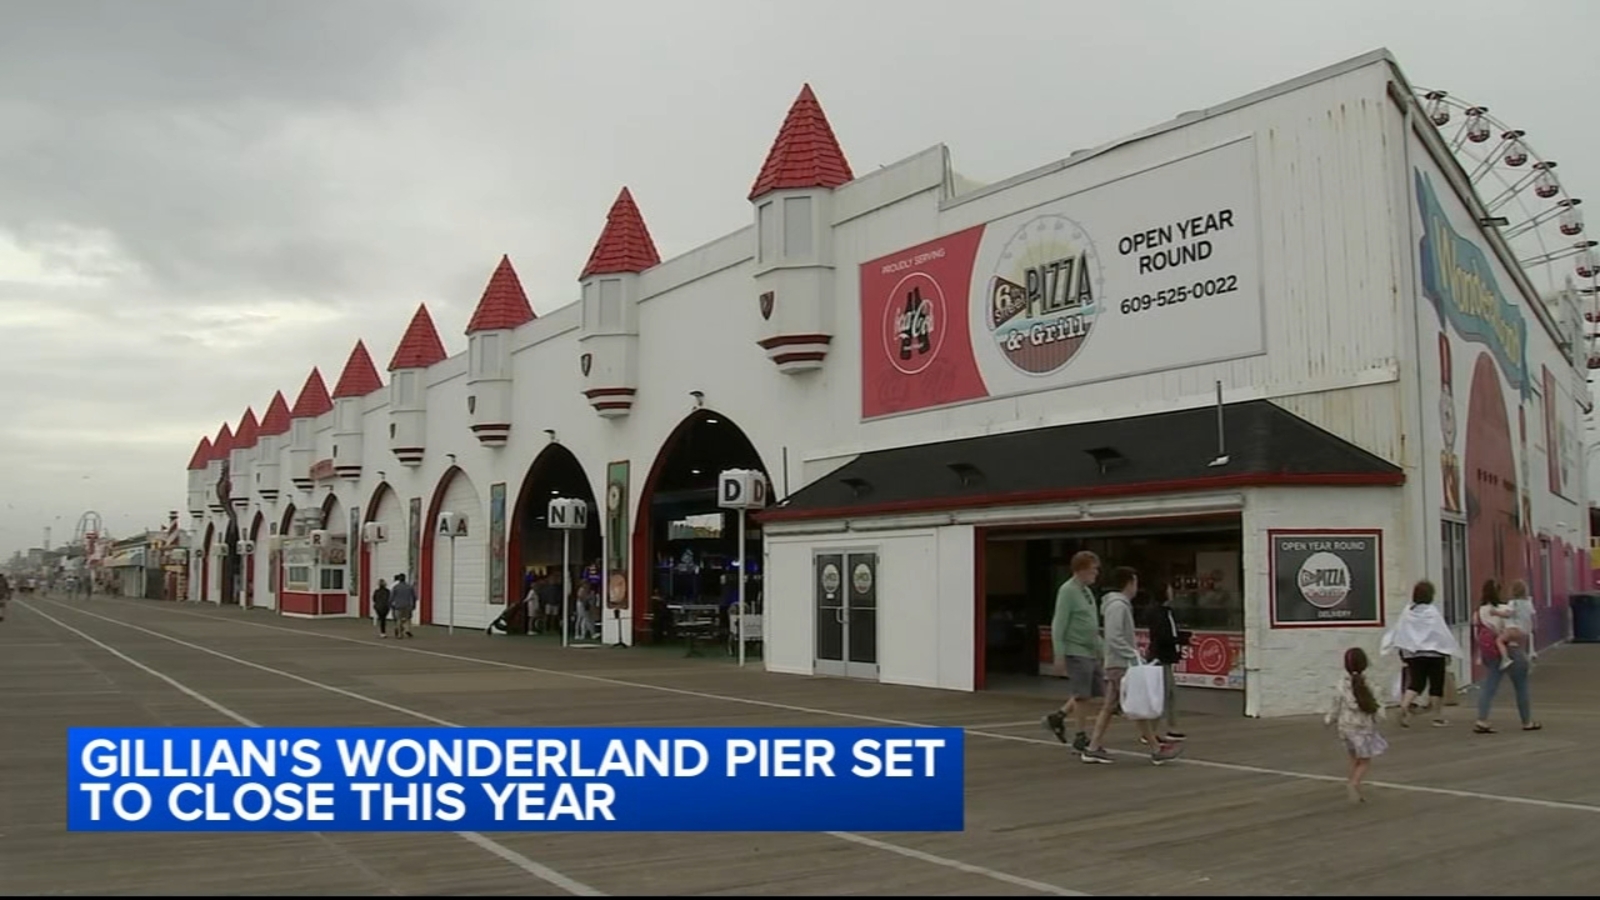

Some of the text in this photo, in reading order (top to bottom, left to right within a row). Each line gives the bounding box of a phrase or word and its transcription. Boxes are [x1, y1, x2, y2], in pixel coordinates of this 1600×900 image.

[1118, 209, 1234, 255] OPEN YEAR
[881, 248, 945, 274] PROUDLY SERVING
[1139, 240, 1212, 275] ROUND
[1025, 250, 1092, 318] PIZZA
[1120, 275, 1238, 314] 609-525-0022
[1006, 315, 1085, 350] & Grill
[724, 479, 741, 501] D
[753, 479, 764, 502] D
[440, 518, 449, 533] A
[551, 505, 565, 524] N
[574, 505, 585, 525] N
[377, 526, 384, 539] L
[456, 519, 467, 533] A
[313, 534, 321, 545] R
[1281, 541, 1365, 551] OPEN YEAR ROUND
